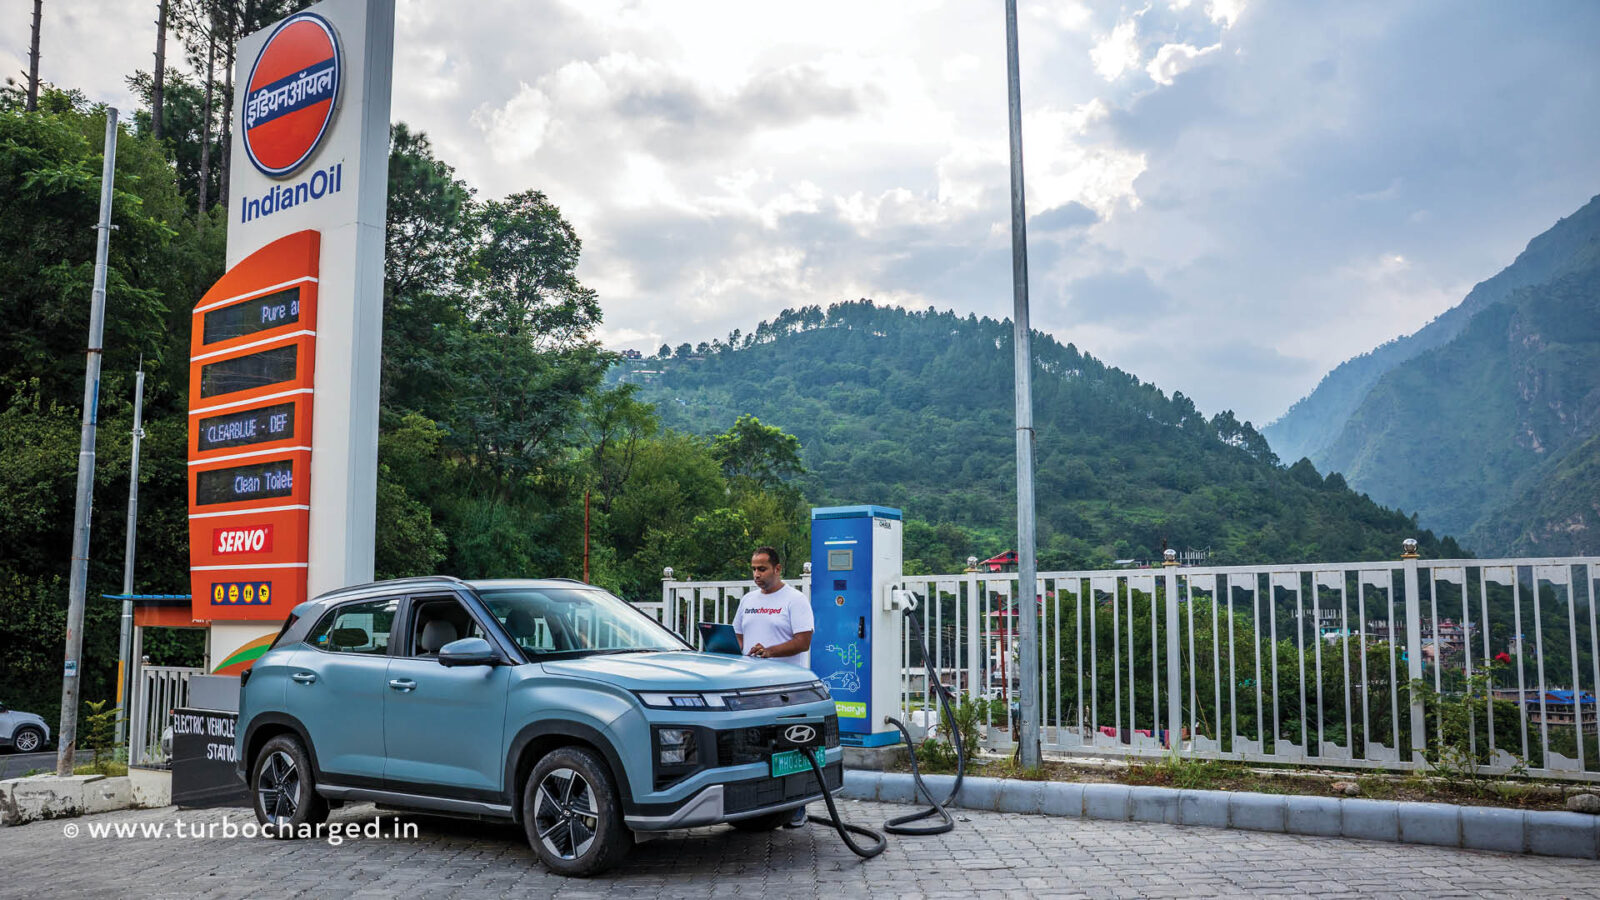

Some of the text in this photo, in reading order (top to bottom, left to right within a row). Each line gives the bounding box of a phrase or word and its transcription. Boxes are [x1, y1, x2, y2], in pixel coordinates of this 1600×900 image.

[241, 163, 342, 224] IndianOil
[262, 304, 286, 323] Pure
[207, 419, 257, 443] CLEARBLUE
[270, 413, 288, 433] DEF
[234, 469, 293, 493] Clean Toilet
[836, 704, 865, 715] Charge
[173, 714, 235, 738] ELECTRIC VEHICLE
